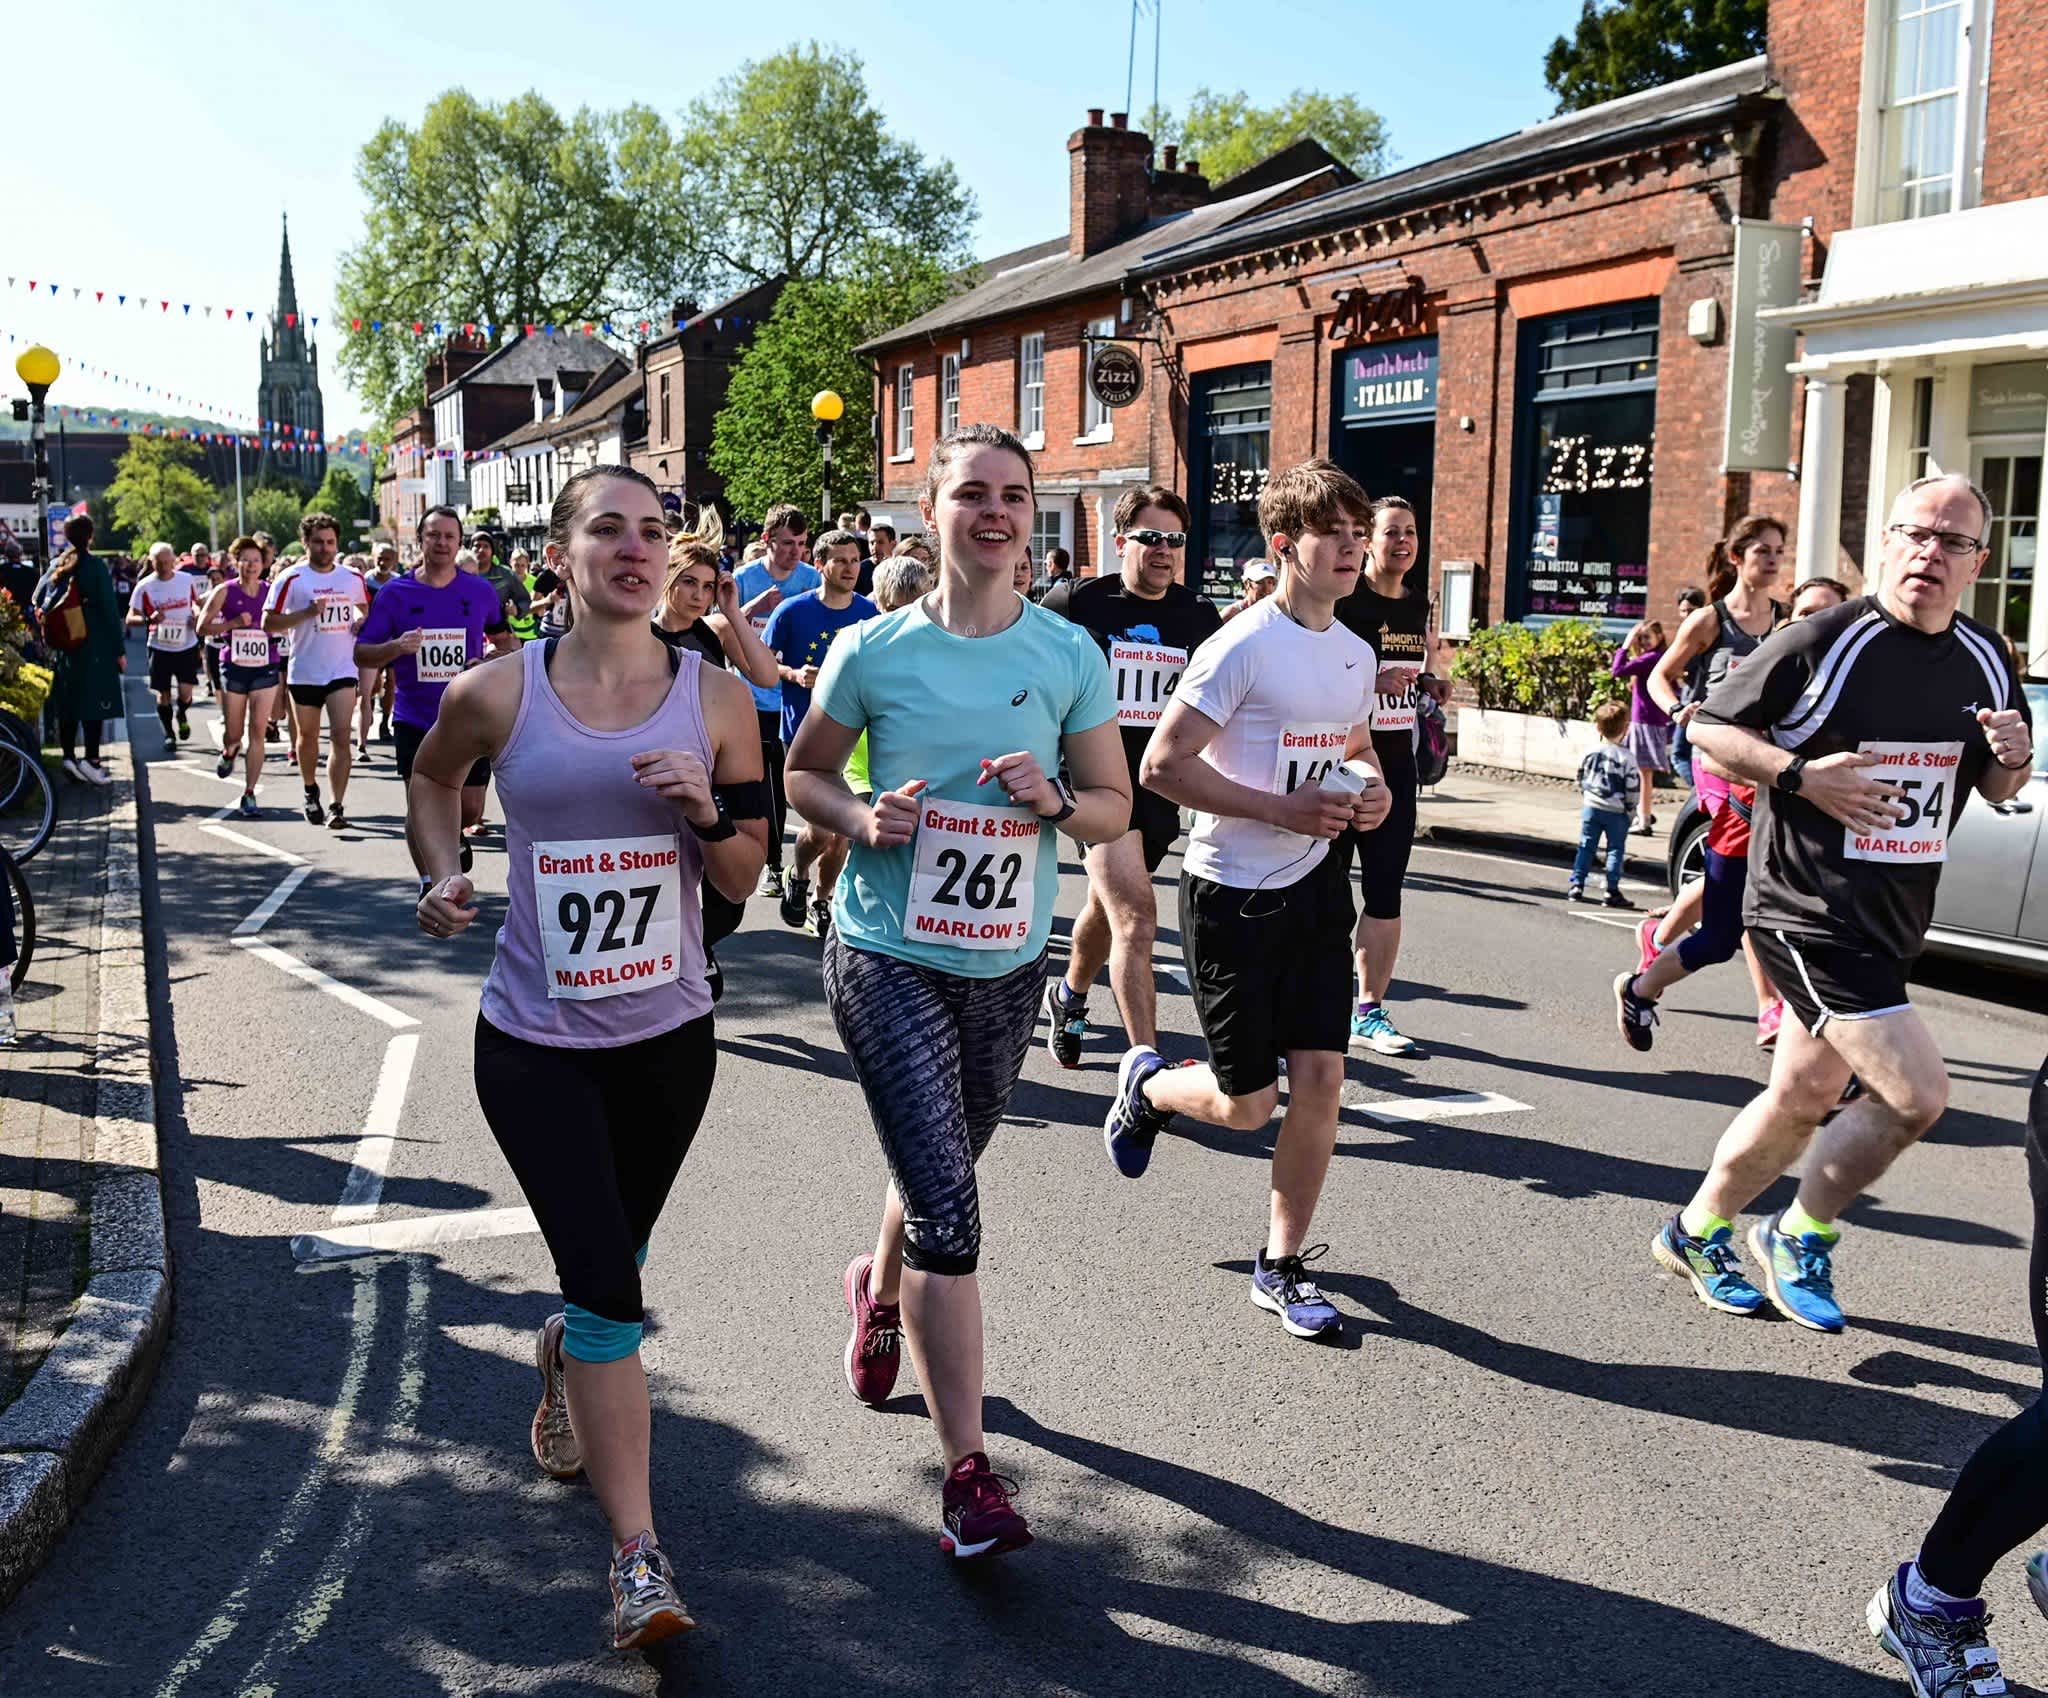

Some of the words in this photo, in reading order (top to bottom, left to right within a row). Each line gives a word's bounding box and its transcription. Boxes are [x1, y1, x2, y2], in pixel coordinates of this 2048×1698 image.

[1097, 368, 1136, 385] Zizzi
[1358, 378, 1424, 408] ITALIAN
[164, 628, 182, 639] 117
[235, 642, 267, 657] 1400
[421, 645, 464, 667] 1068
[1114, 647, 1144, 660] Grant
[1145, 650, 1153, 661] &
[1155, 651, 1186, 664] Stone
[1117, 668, 1180, 702] 1114
[1377, 715, 1414, 725] MARLOW
[1283, 732, 1318, 748] Grant
[1320, 733, 1328, 747] &
[1907, 752, 1921, 766] &
[925, 809, 979, 836] Grant
[982, 818, 997, 837] &
[1000, 818, 1040, 838] Stone
[1855, 837, 1932, 854] MARLOW
[1934, 840, 1942, 852] 5
[538, 854, 595, 874] Grant
[598, 852, 615, 873] &
[619, 850, 678, 871] Stone
[931, 848, 1022, 910] 262
[558, 884, 662, 955] 927
[916, 915, 1012, 939] MARLOW
[1017, 921, 1027, 937] 5
[555, 958, 656, 988] MARLOW
[661, 954, 673, 971] 5
